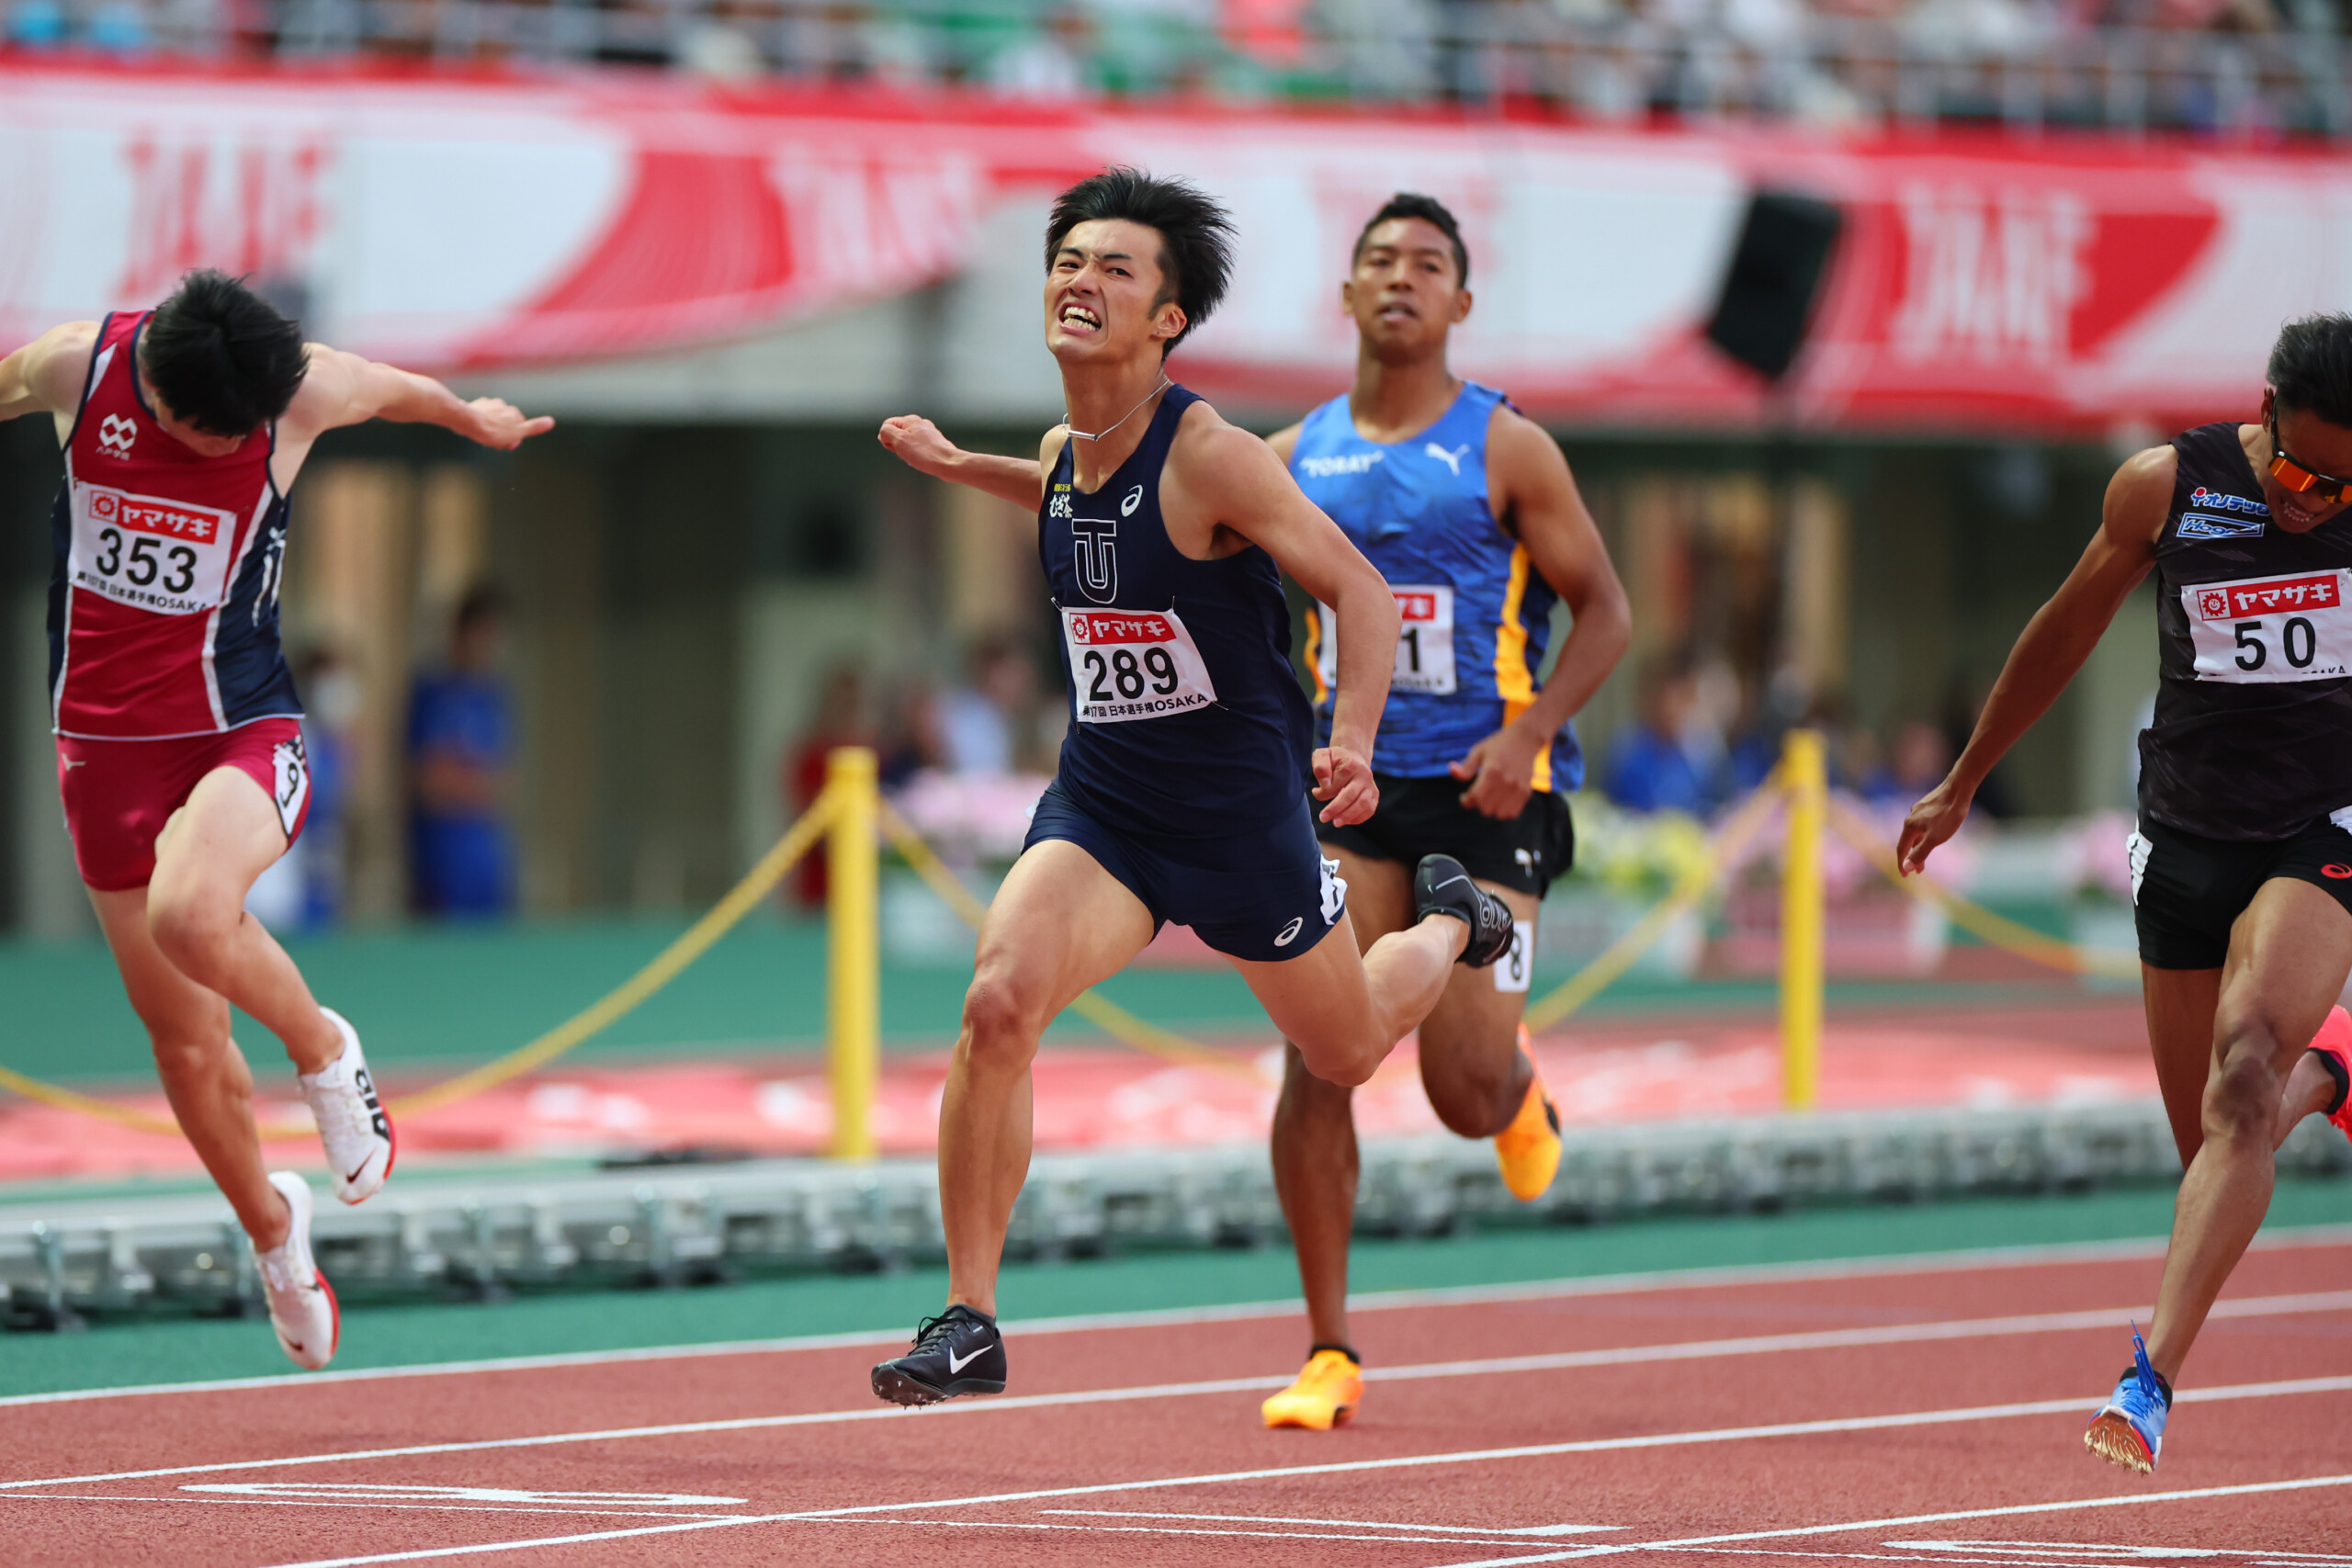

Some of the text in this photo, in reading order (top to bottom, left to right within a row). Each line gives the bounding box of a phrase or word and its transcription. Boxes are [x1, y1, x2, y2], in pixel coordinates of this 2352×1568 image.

[121, 505, 212, 536] ヤマザキ
[96, 528, 197, 593] 353
[2234, 583, 2332, 610] ヤマザキ
[1092, 620, 1166, 637] ヤマザキ
[2234, 617, 2316, 671] 50
[1084, 647, 1179, 701] 289
